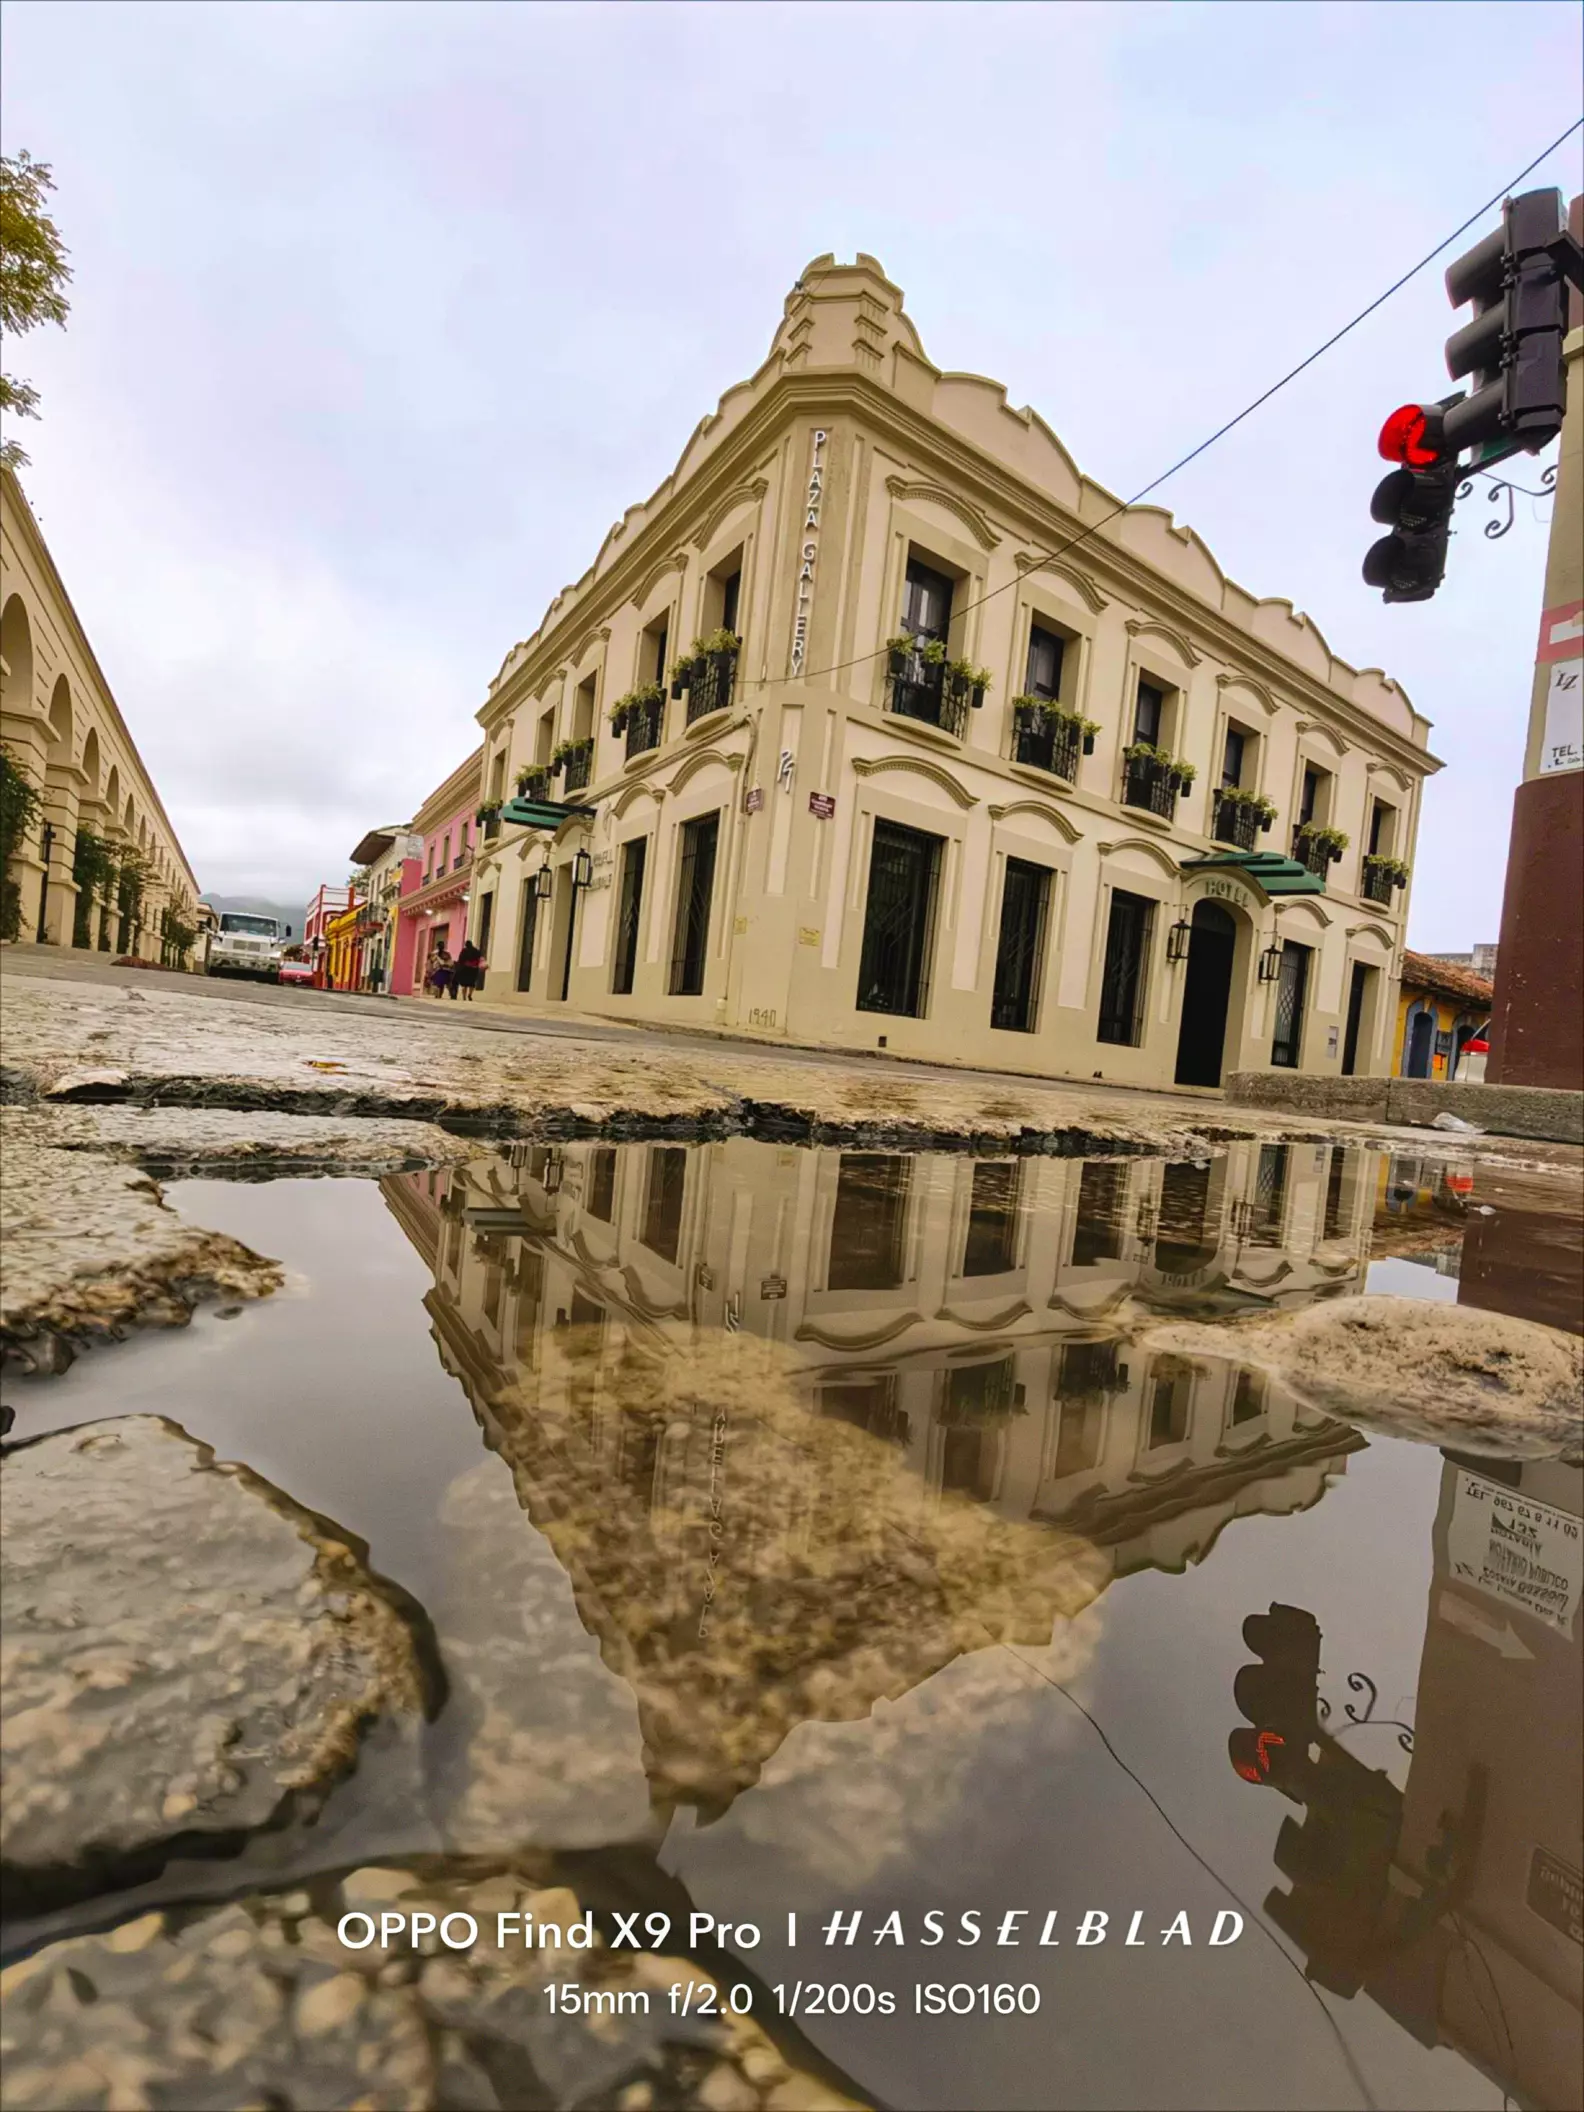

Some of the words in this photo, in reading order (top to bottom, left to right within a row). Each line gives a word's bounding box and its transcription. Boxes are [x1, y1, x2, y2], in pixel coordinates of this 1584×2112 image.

[805, 430, 827, 530] PLAZA
[791, 541, 817, 678] GALLERY
[1204, 879, 1248, 908] HOTEL
[748, 1007, 777, 1028] 1940
